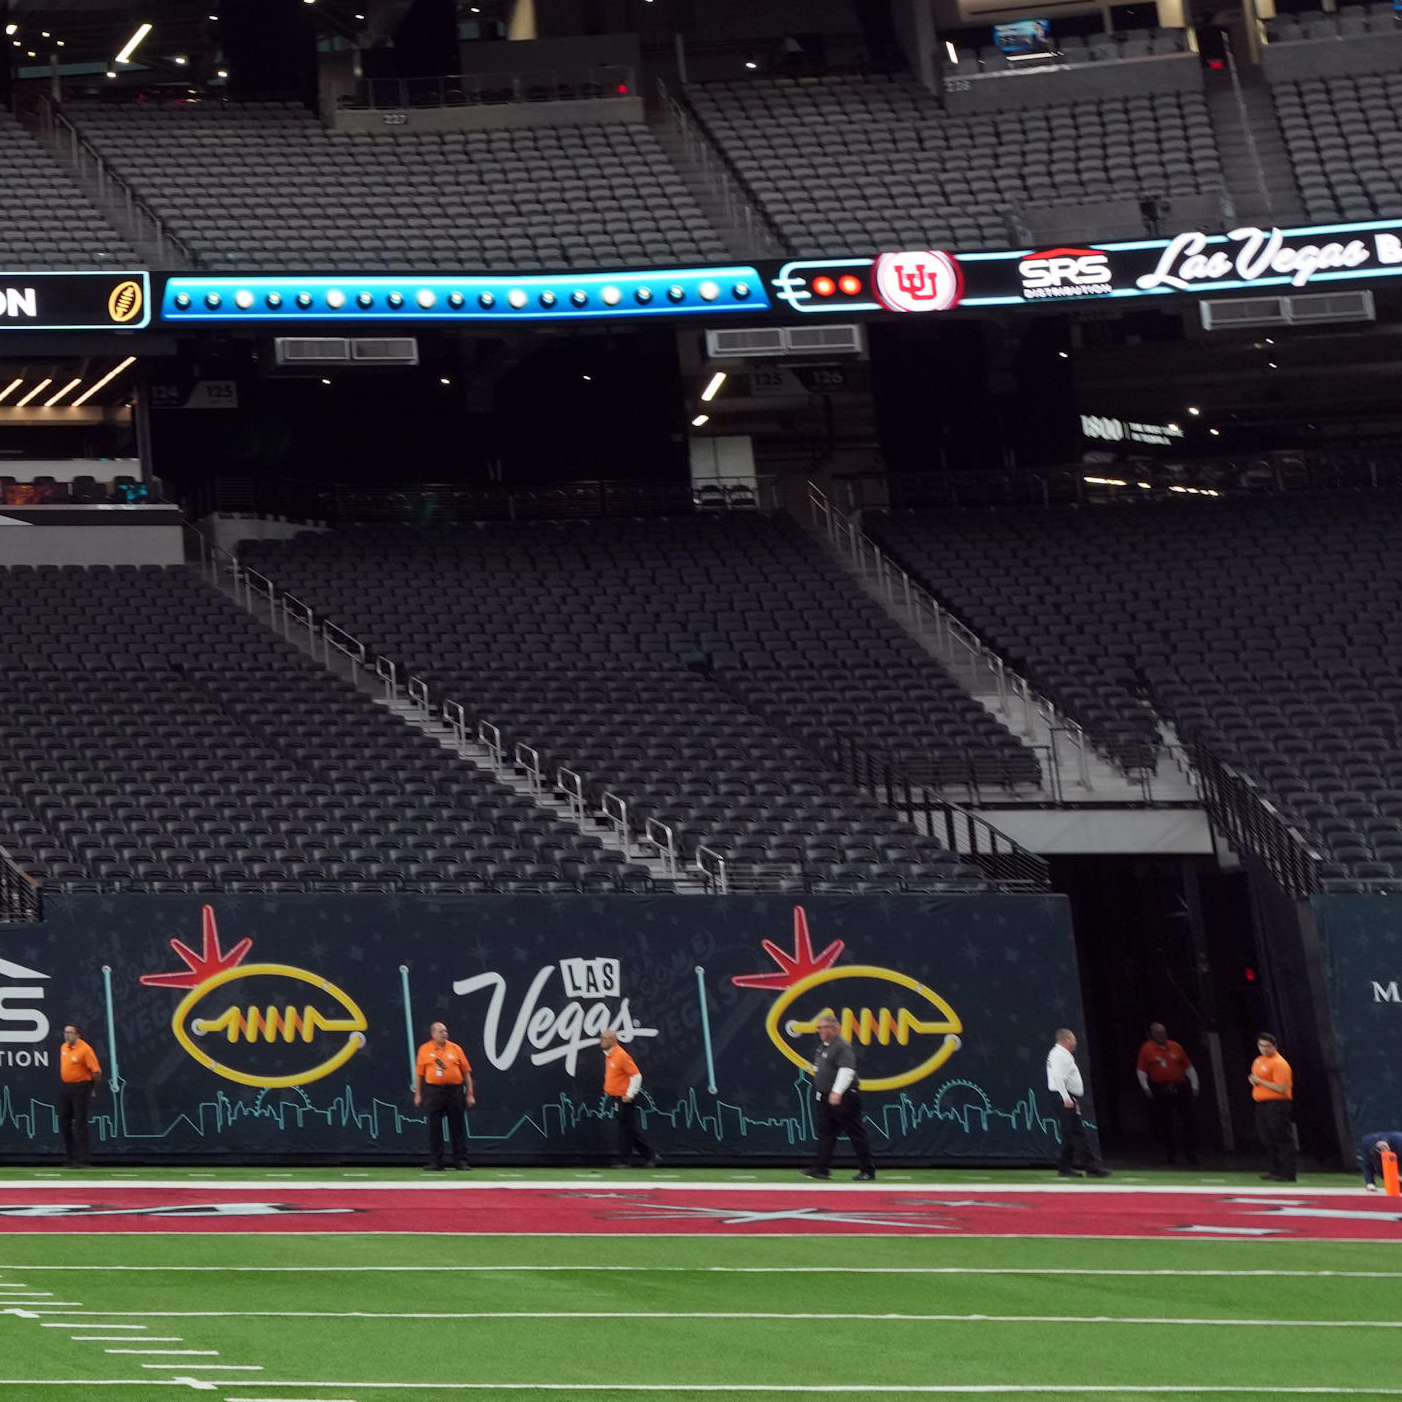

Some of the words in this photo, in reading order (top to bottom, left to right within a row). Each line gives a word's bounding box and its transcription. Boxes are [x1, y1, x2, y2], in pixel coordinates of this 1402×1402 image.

[1018, 255, 1112, 288] SRS
[1136, 231, 1231, 291] Las
[1226, 226, 1371, 287] Vegas
[206, 385, 233, 398] 125
[569, 961, 616, 994] LAS
[453, 965, 659, 1077] Vegas
